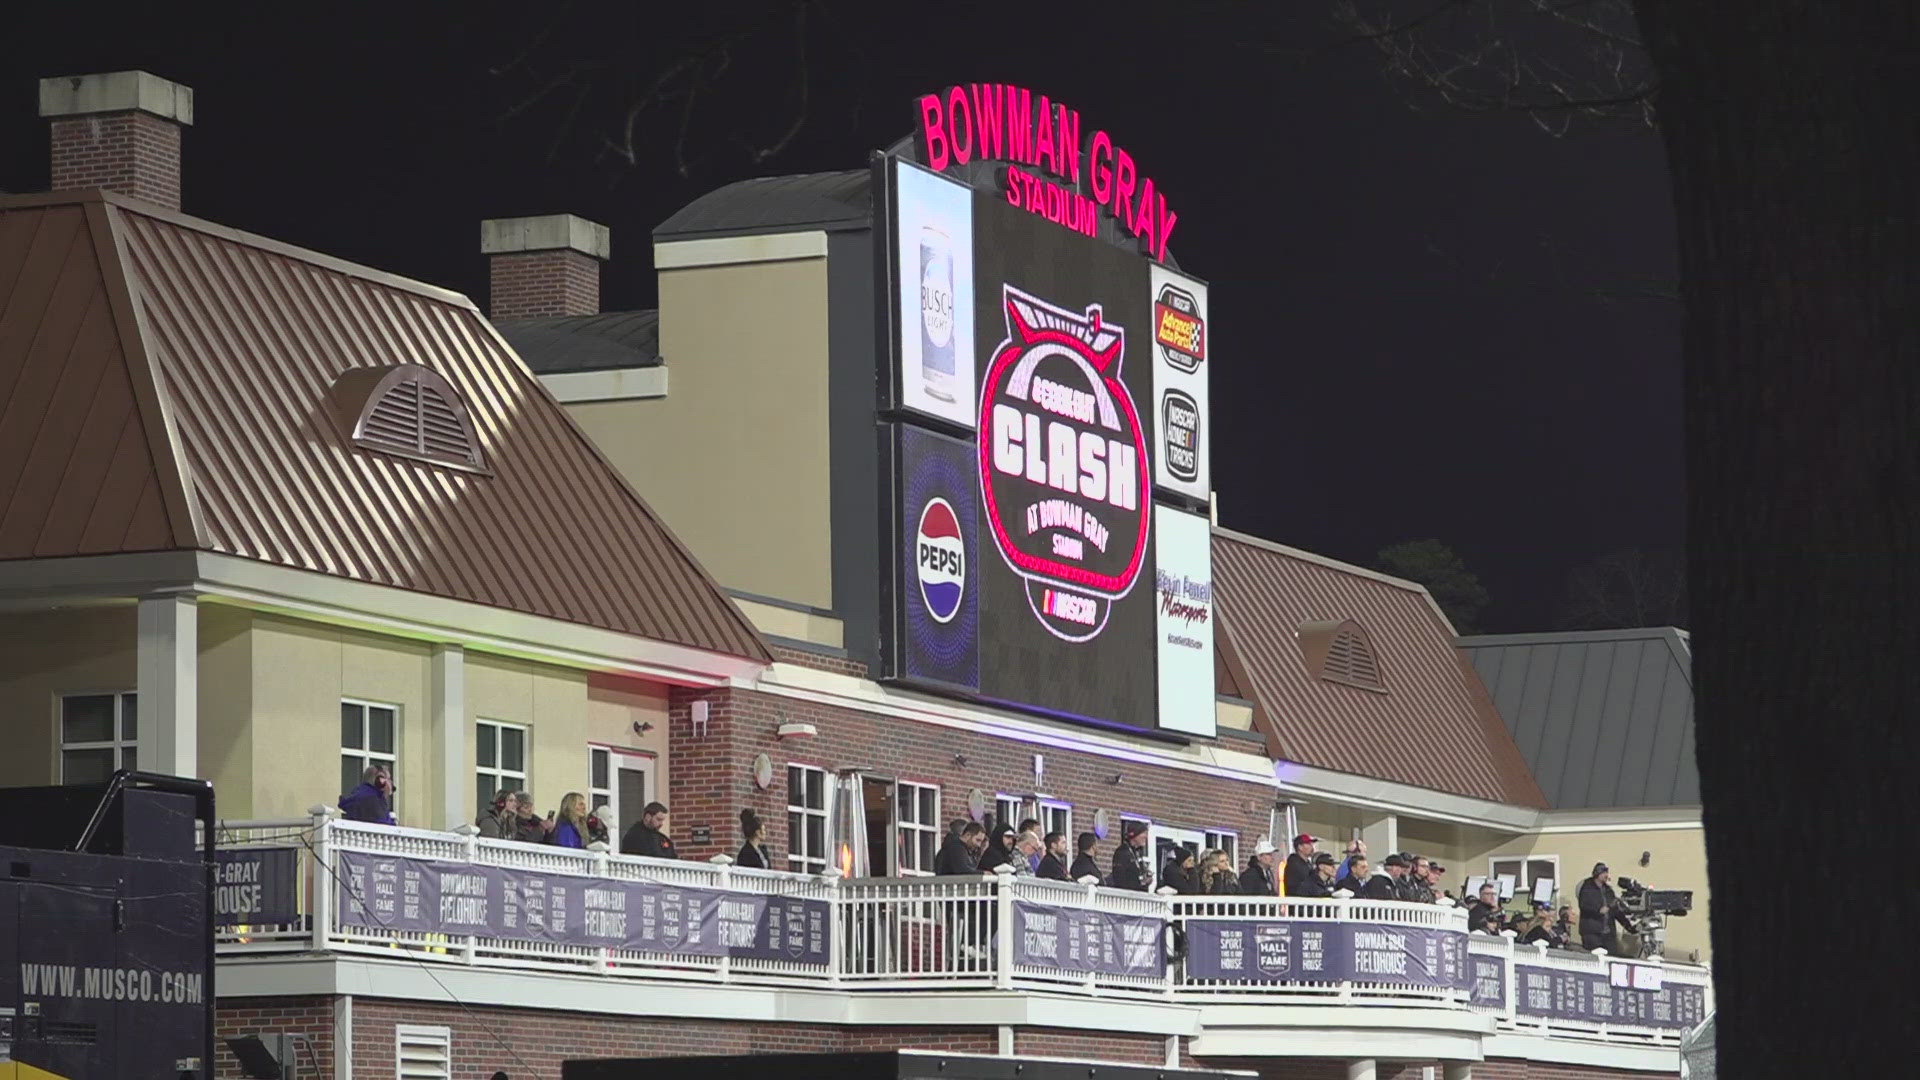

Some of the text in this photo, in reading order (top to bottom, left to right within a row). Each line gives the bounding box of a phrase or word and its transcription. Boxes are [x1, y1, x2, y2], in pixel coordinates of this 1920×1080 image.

[920, 83, 1177, 264] BOWMAN GRAY
[1006, 165, 1097, 238] STADIUM
[1169, 401, 1196, 431] NASCAR
[1168, 425, 1186, 447] HOME
[993, 403, 1136, 511] CLASH
[1169, 445, 1194, 469] TRACKS
[1026, 499, 1109, 554] AT BOWMAN GRAY
[920, 542, 962, 577] PEPSI
[1057, 591, 1097, 626] NASCAR
[375, 882, 394, 896] HALL
[375, 900, 394, 912] FAME
[663, 910, 679, 922] HALL
[663, 925, 680, 937] FAME
[788, 935, 804, 947] FAME
[1260, 943, 1287, 953] HALL
[1260, 956, 1288, 966] FAME
[1355, 950, 1407, 975] FIELDHOUSE
[21, 963, 202, 1004] WWW.MUSCO.COM
